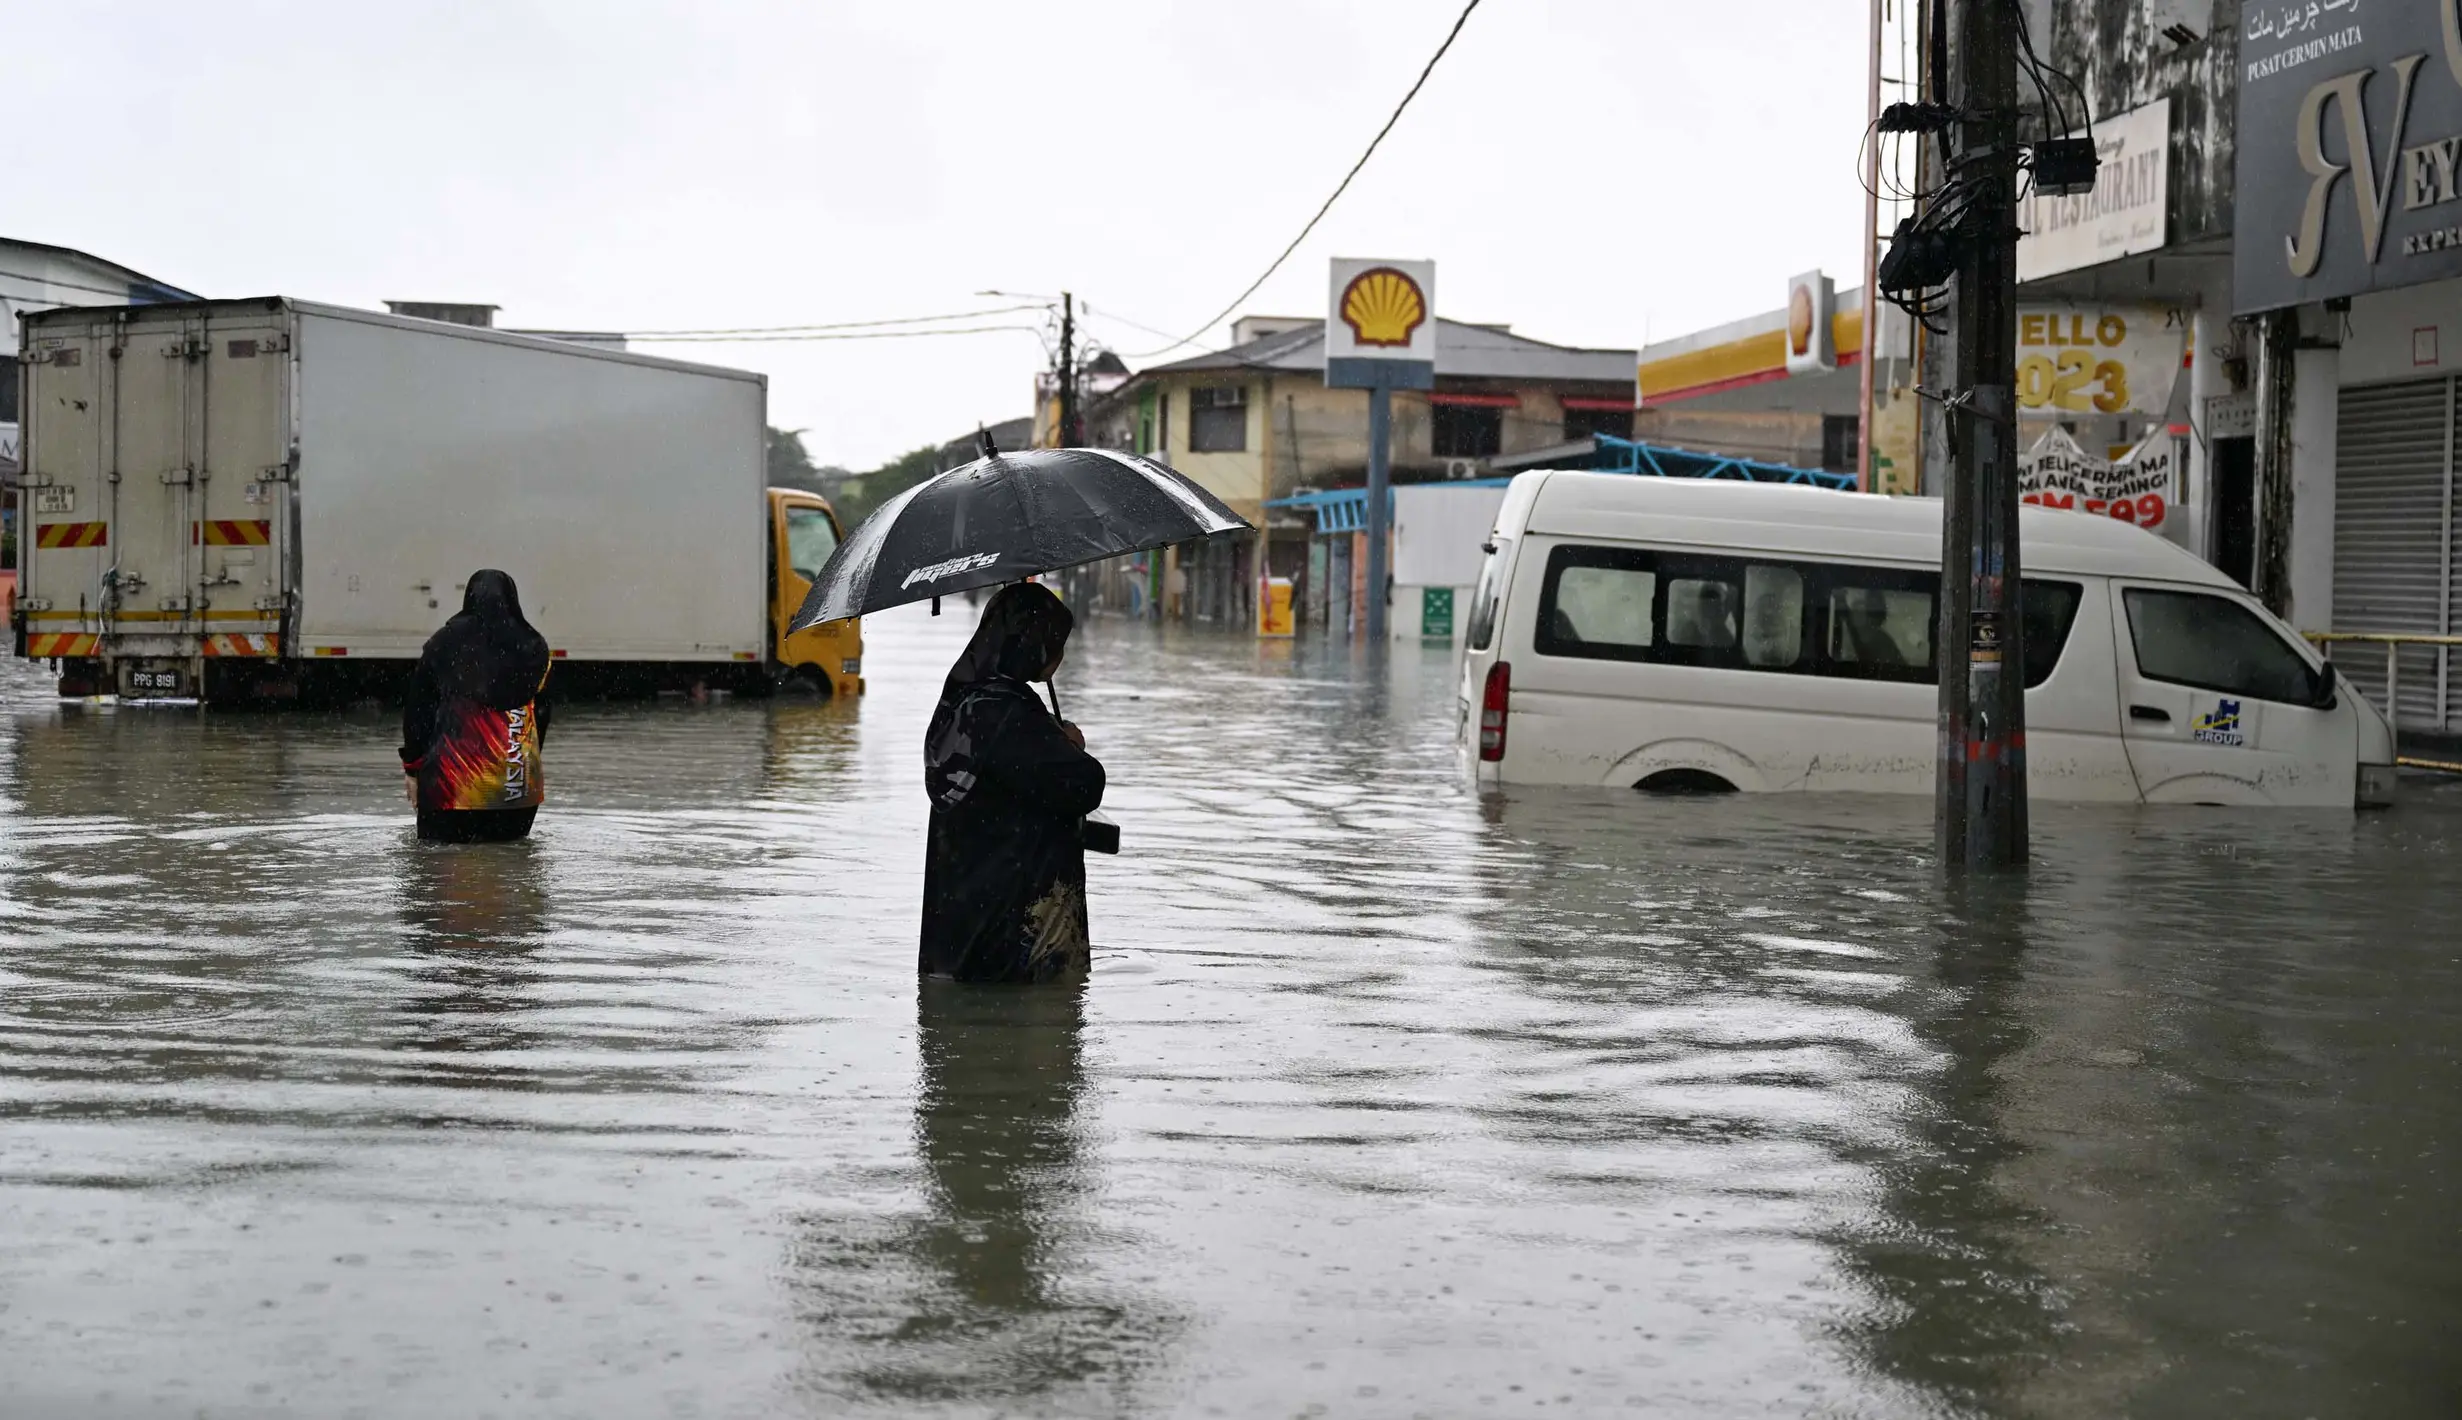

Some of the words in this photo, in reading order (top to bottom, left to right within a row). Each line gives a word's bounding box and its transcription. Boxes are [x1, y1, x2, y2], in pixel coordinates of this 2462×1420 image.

[2248, 53, 2282, 82] PUSAT
[2281, 36, 2327, 69] CERMIN
[2327, 25, 2363, 53] MATA
[2402, 136, 2462, 210] EY
[2021, 314, 2127, 347] ELLO
[2016, 349, 2130, 413] 023
[2140, 454, 2168, 475] MA
[2093, 473, 2168, 500] SEHING
[133, 672, 152, 687] PPG
[156, 674, 176, 688] 8191
[2194, 730, 2243, 747] GROUP
